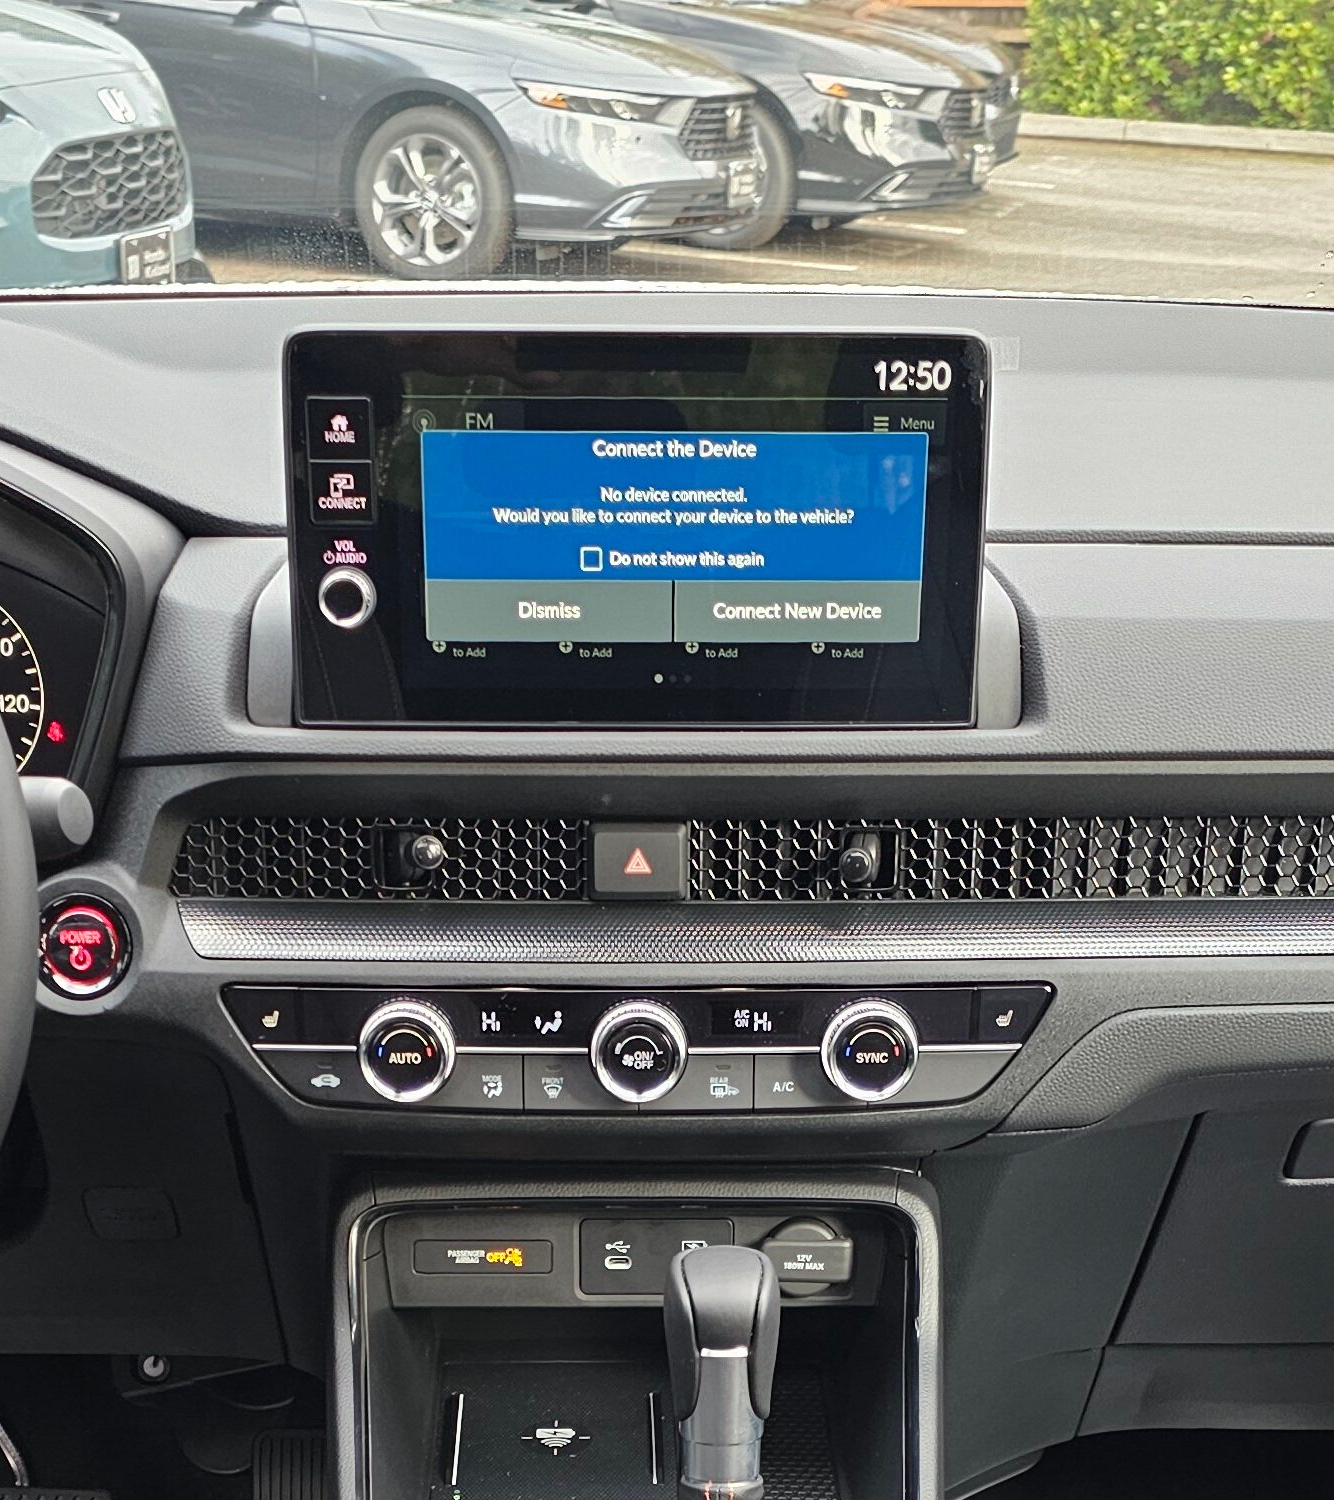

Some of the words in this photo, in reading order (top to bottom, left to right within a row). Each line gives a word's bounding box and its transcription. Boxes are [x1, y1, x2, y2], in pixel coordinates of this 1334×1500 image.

[874, 360, 952, 391] 12:50
[465, 413, 494, 430] FM
[900, 417, 935, 430] Menu
[324, 431, 355, 443] HOME
[592, 439, 664, 458] Connect
[667, 439, 695, 458] the
[699, 439, 757, 458] Device
[599, 486, 622, 502] No
[624, 486, 669, 502] device
[672, 487, 748, 503] connected.
[318, 497, 367, 510] CONNECT
[492, 507, 540, 523] Would
[541, 510, 568, 525] you
[571, 507, 596, 523] like
[598, 509, 614, 523] to
[616, 509, 672, 524] connect
[674, 510, 706, 526] your
[709, 508, 753, 524] device
[756, 509, 771, 524] to
[774, 508, 798, 524] the
[799, 508, 855, 525] vehicle?
[334, 540, 356, 551] VOL
[336, 552, 367, 564] AUDIO
[609, 550, 631, 566] Do
[633, 550, 659, 566] not
[660, 551, 697, 567] show
[699, 551, 725, 567] this
[727, 551, 765, 568] again
[518, 601, 581, 619] Dismiss
[713, 602, 781, 619] Connect
[785, 602, 822, 619] New
[826, 602, 882, 619] Device
[453, 648, 464, 658] to
[465, 648, 486, 658] Add
[579, 648, 590, 658] to
[592, 648, 612, 658] Add
[705, 649, 716, 658] to
[718, 649, 738, 658] Add
[831, 649, 842, 658] to
[843, 649, 864, 658] Add
[59, 930, 102, 944] POWER
[734, 1009, 750, 1019] A/C
[735, 1019, 748, 1028] ON
[388, 1052, 422, 1065] AUTO
[634, 1051, 654, 1061] ON/
[855, 1052, 889, 1065] SYNC
[634, 1060, 654, 1070] OFF
[541, 1077, 564, 1085] FRONT
[773, 1082, 795, 1092] A/C
[796, 1254, 812, 1262] 12V
